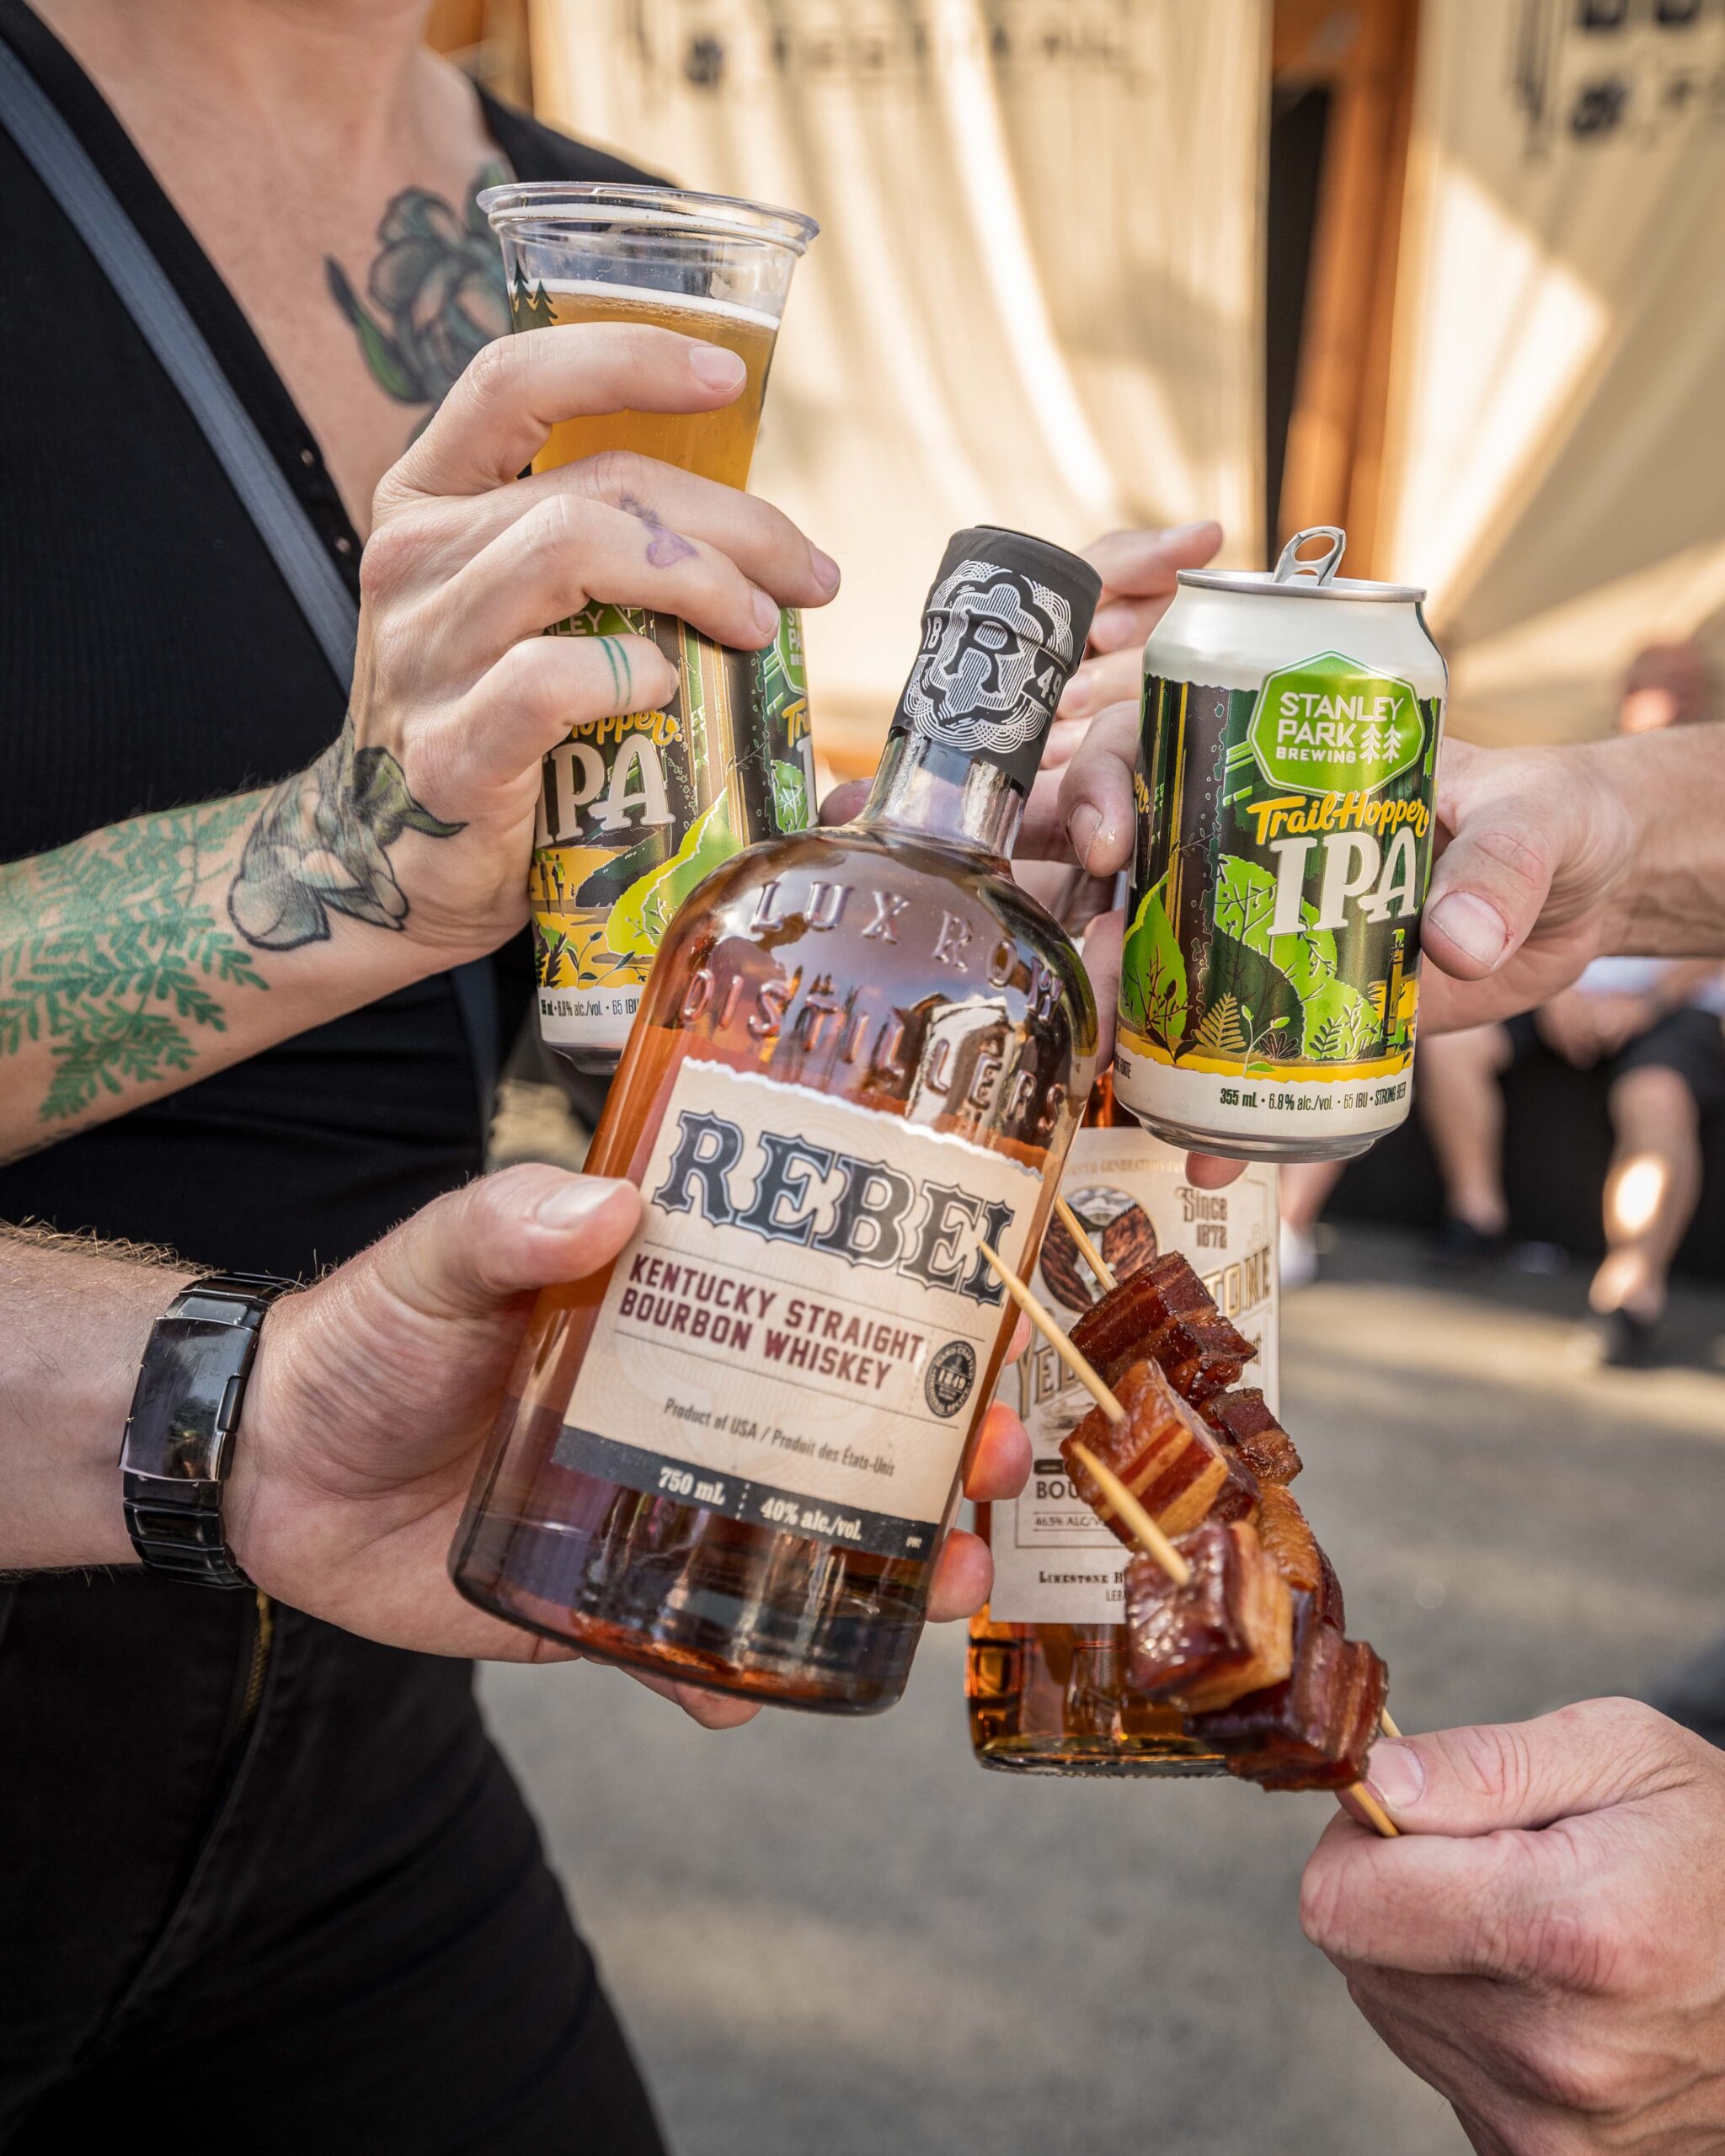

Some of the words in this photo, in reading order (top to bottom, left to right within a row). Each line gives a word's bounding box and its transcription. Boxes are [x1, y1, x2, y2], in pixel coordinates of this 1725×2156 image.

[1036, 666, 1063, 707] 49
[1279, 691, 1404, 722] STANLEY
[1275, 746, 1357, 764] BREWING
[1277, 718, 1357, 748] PARK
[1266, 826, 1419, 936] IPA
[751, 880, 911, 945] LUX
[612, 999, 623, 1016] 65
[1220, 1087, 1239, 1105] 355
[1242, 1091, 1258, 1108] mL
[1268, 1092, 1295, 1111] 6.8%
[1297, 1094, 1333, 1111] alc./vol.
[1343, 1093, 1354, 1109] 65
[1355, 1091, 1368, 1108] IBU
[1375, 1084, 1397, 1107] STRONG
[1397, 1081, 1407, 1101] BEER
[652, 1109, 1016, 1308] REBEL
[1176, 1187, 1227, 1222] Since
[628, 1254, 777, 1320] KENTUCKY
[784, 1299, 925, 1364] STRAIGHT
[619, 1288, 753, 1351] BOURBON
[762, 1328, 893, 1390] WHISKEY
[664, 1398, 711, 1428] Product
[714, 1415, 728, 1430] of
[730, 1418, 756, 1440] USA
[771, 1428, 816, 1457] Produit
[818, 1443, 840, 1463] des
[842, 1445, 895, 1477] États-Unis
[658, 1466, 695, 1496] 750
[693, 1481, 727, 1506] mL
[760, 1497, 801, 1526] 40%
[800, 1509, 862, 1541] alc./vol.
